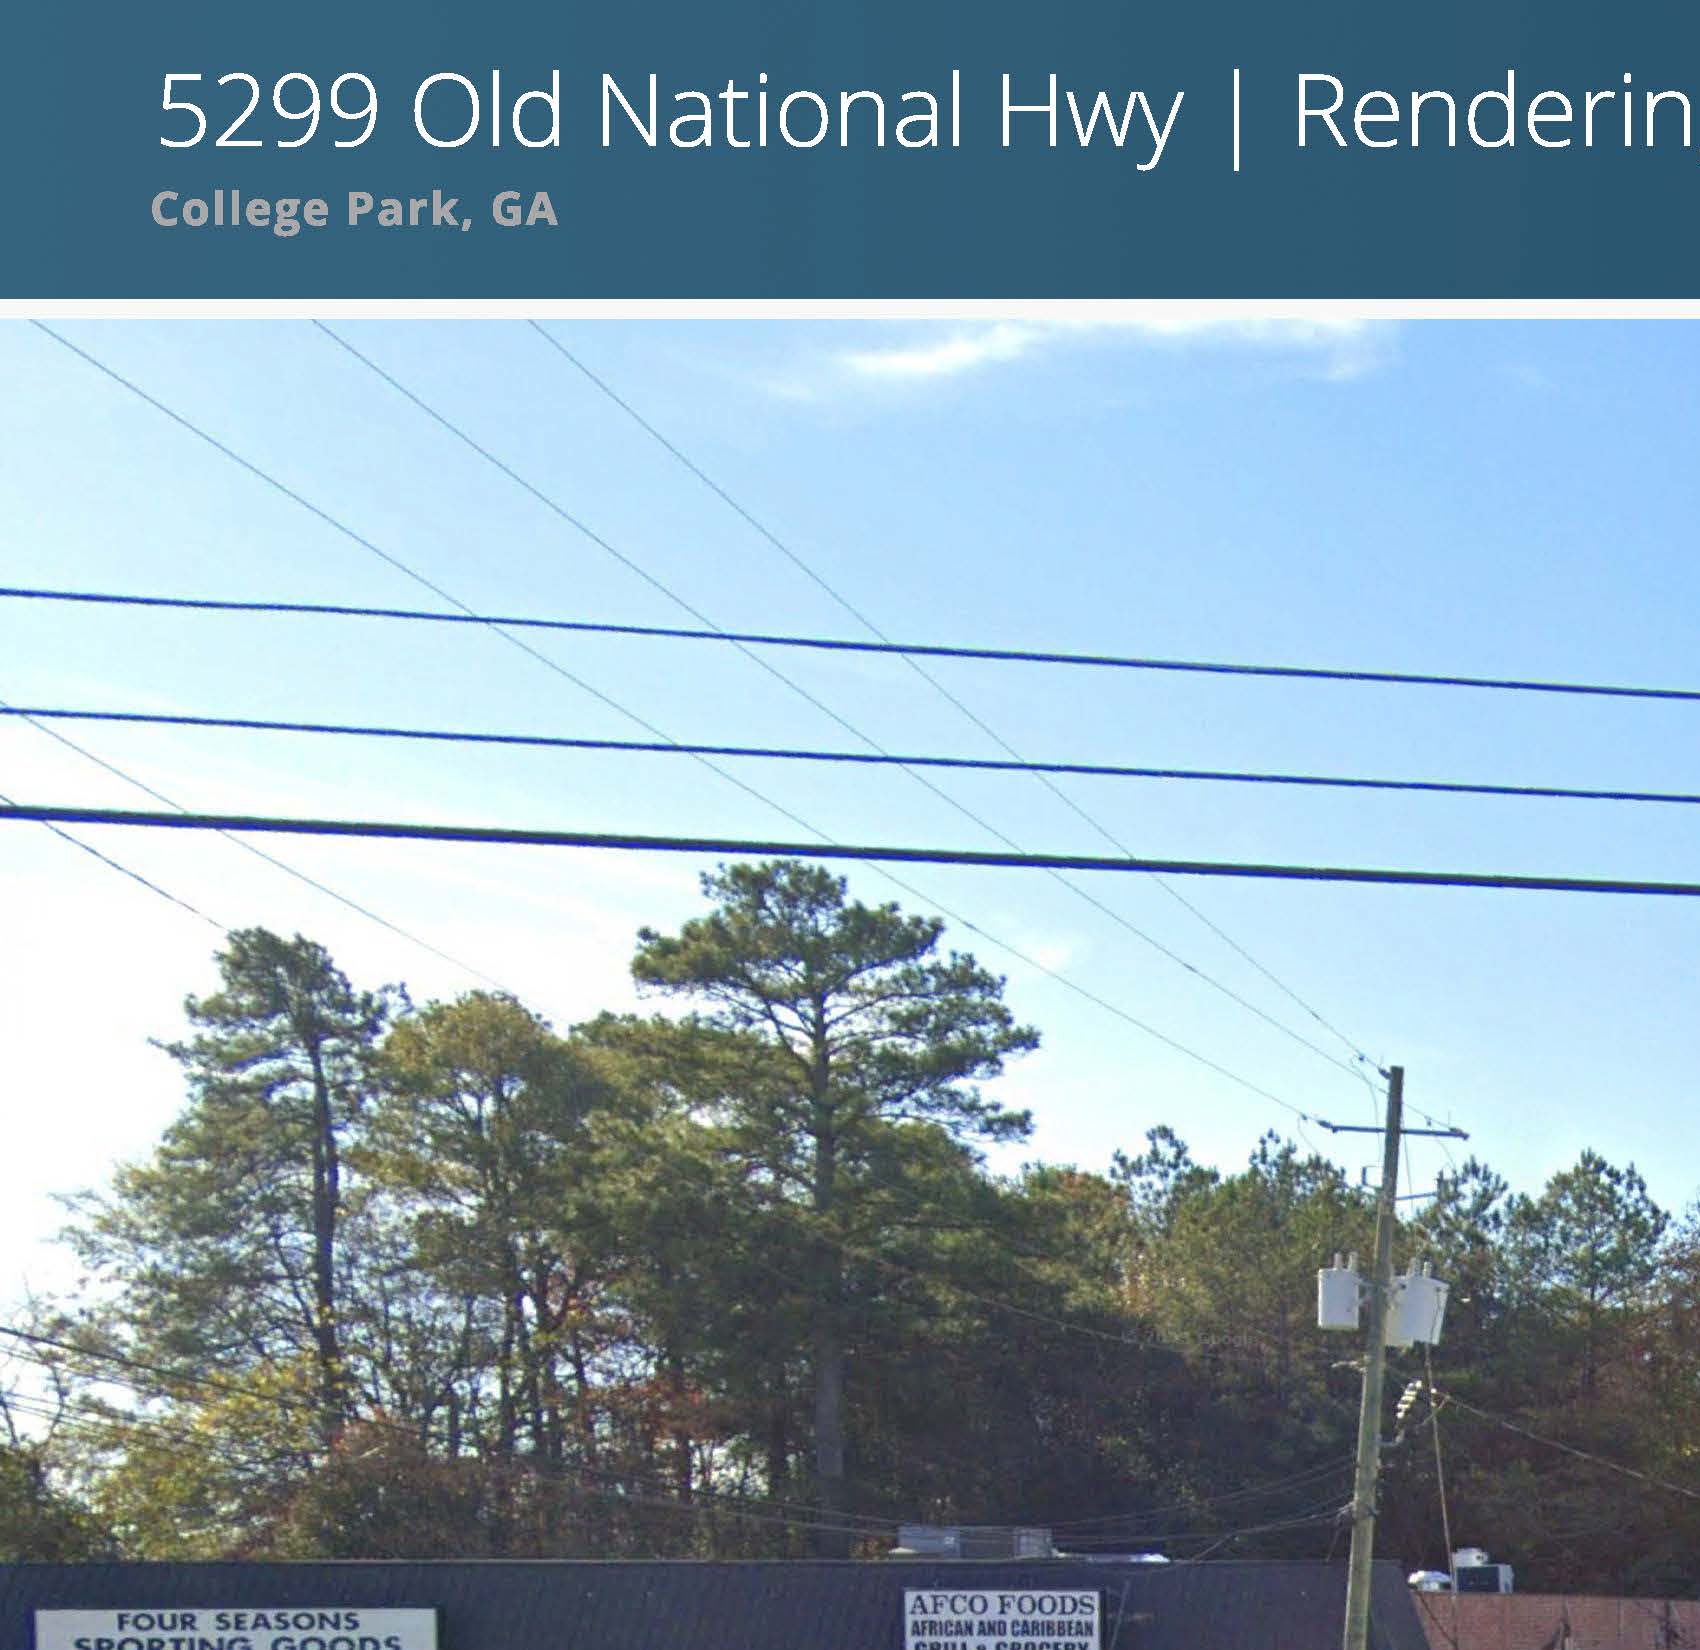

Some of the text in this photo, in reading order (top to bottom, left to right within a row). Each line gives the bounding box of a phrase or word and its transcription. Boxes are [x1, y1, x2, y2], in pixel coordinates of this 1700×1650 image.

[909, 1594, 1095, 1615] AFCO FOODS
[116, 1612, 361, 1632] FOUR SEASONS
[911, 1619, 1094, 1638] AFRICAN AND CARIBBEAN
